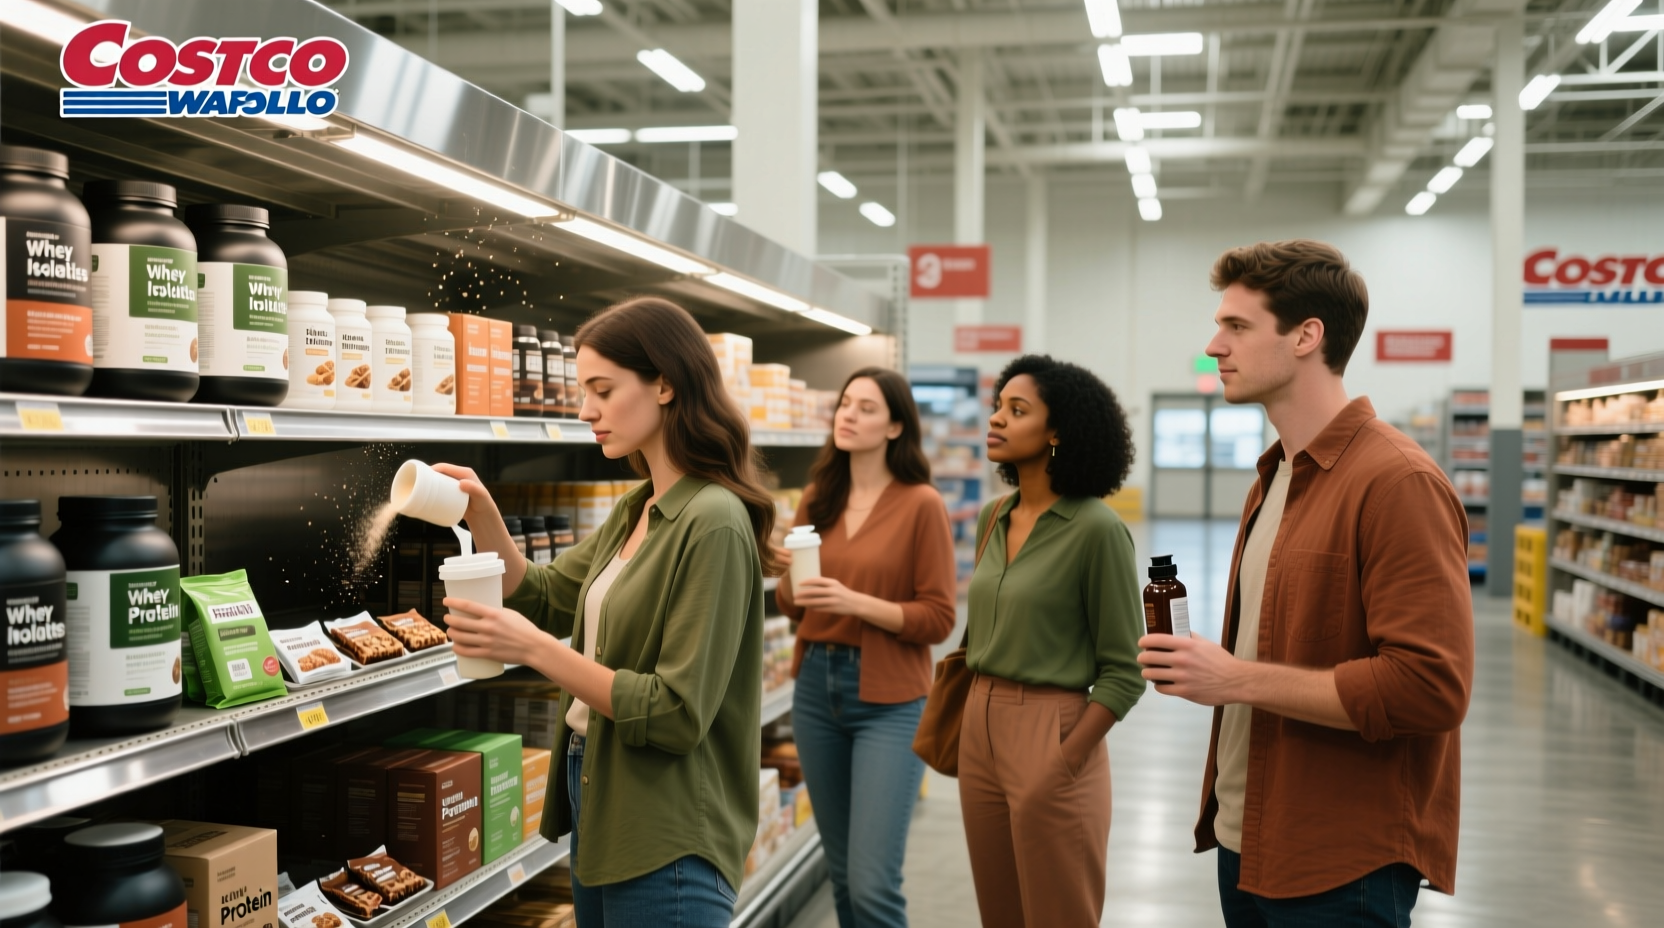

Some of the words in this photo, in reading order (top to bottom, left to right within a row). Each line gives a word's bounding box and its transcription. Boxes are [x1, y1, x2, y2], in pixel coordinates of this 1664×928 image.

[26, 239, 74, 262] Whey
[146, 263, 187, 284] Whey
[127, 587, 170, 606] Whey
[5, 603, 54, 625] Whey
[220, 887, 272, 926] Protein
